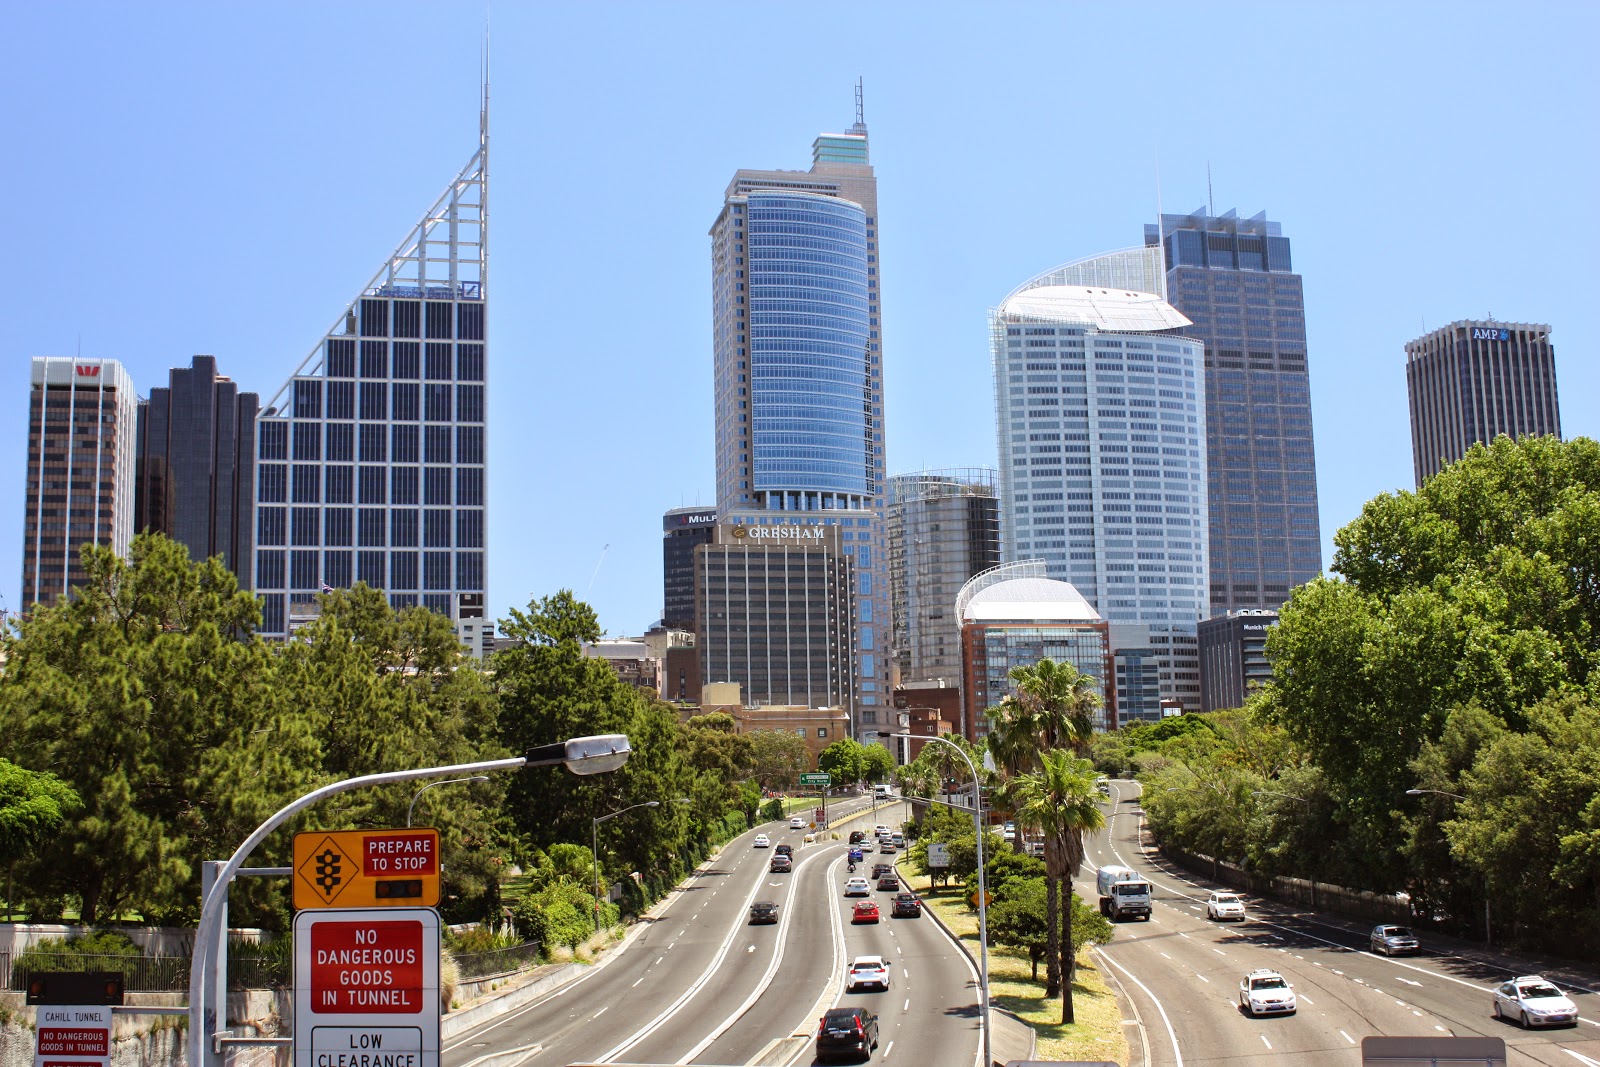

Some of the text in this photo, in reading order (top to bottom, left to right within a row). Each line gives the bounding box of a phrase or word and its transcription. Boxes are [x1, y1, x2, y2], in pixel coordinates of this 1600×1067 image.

[1473, 328, 1498, 340] AMP
[749, 528, 824, 539] GRESHAM
[369, 840, 431, 854] PREPARE
[372, 857, 427, 871] TO STOP
[355, 929, 377, 944] NO
[317, 949, 416, 965] DANGEROUS
[340, 970, 393, 985] GOODS
[322, 990, 410, 1005] IN TUNNEL
[45, 1012, 103, 1021] CAHILL TUNNEL
[43, 1032, 104, 1040] NO DANGEROUS
[350, 1034, 382, 1049] LOW
[41, 1043, 105, 1051] GOODS IN TUNNEL
[318, 1054, 415, 1067] CLEARANCE
